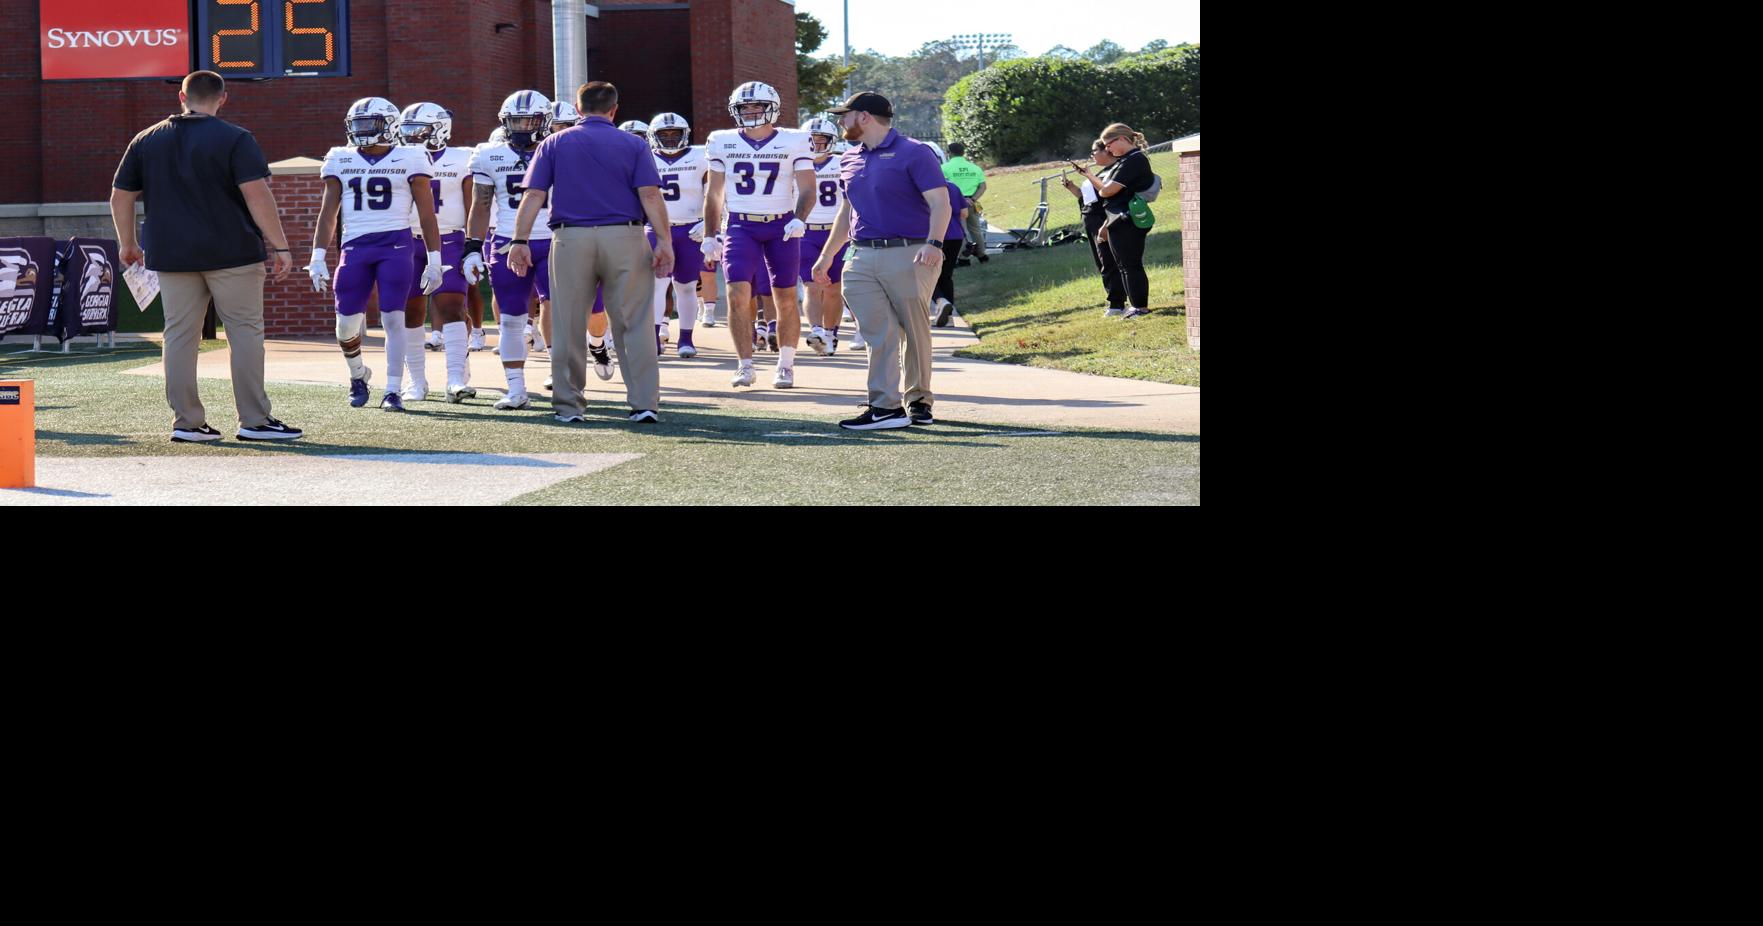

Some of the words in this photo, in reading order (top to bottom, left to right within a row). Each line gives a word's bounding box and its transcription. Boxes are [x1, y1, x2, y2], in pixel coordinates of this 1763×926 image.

[47, 28, 178, 49] SYNOVUS
[212, 0, 333, 68] 25
[661, 174, 680, 201] 5
[733, 161, 780, 195] 37
[819, 180, 837, 206] 8
[347, 176, 392, 211] 19
